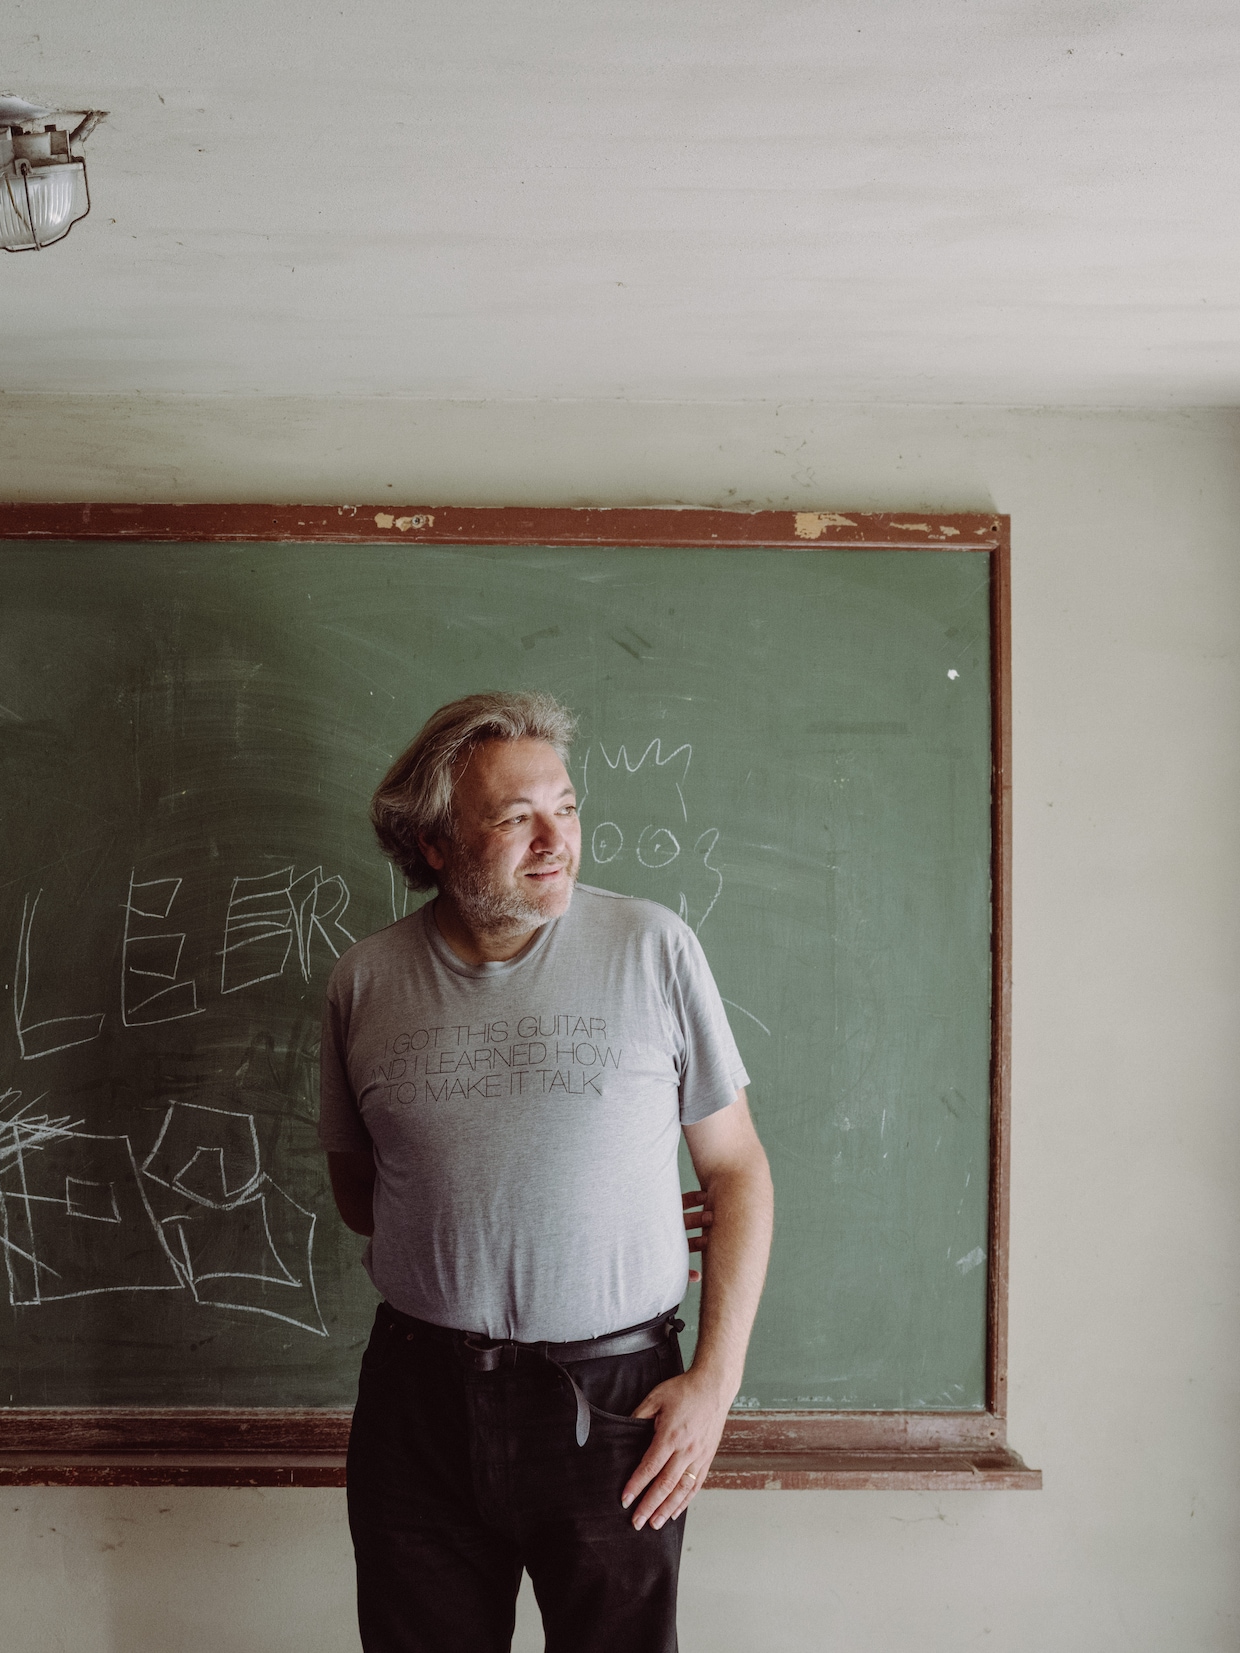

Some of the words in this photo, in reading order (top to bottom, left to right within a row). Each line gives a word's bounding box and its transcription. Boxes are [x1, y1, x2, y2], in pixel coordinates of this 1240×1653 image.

[383, 1039, 389, 1059] I
[392, 1026, 445, 1055] GOT
[450, 1020, 510, 1047] THIS
[516, 1014, 607, 1040] GUITAR
[413, 1055, 419, 1077] I
[425, 1041, 547, 1075] LEARNED
[556, 1042, 623, 1070] HOW
[383, 1081, 417, 1105] TO
[425, 1074, 502, 1103] MAKE
[510, 1070, 530, 1096] IT
[539, 1069, 603, 1097] TALK
